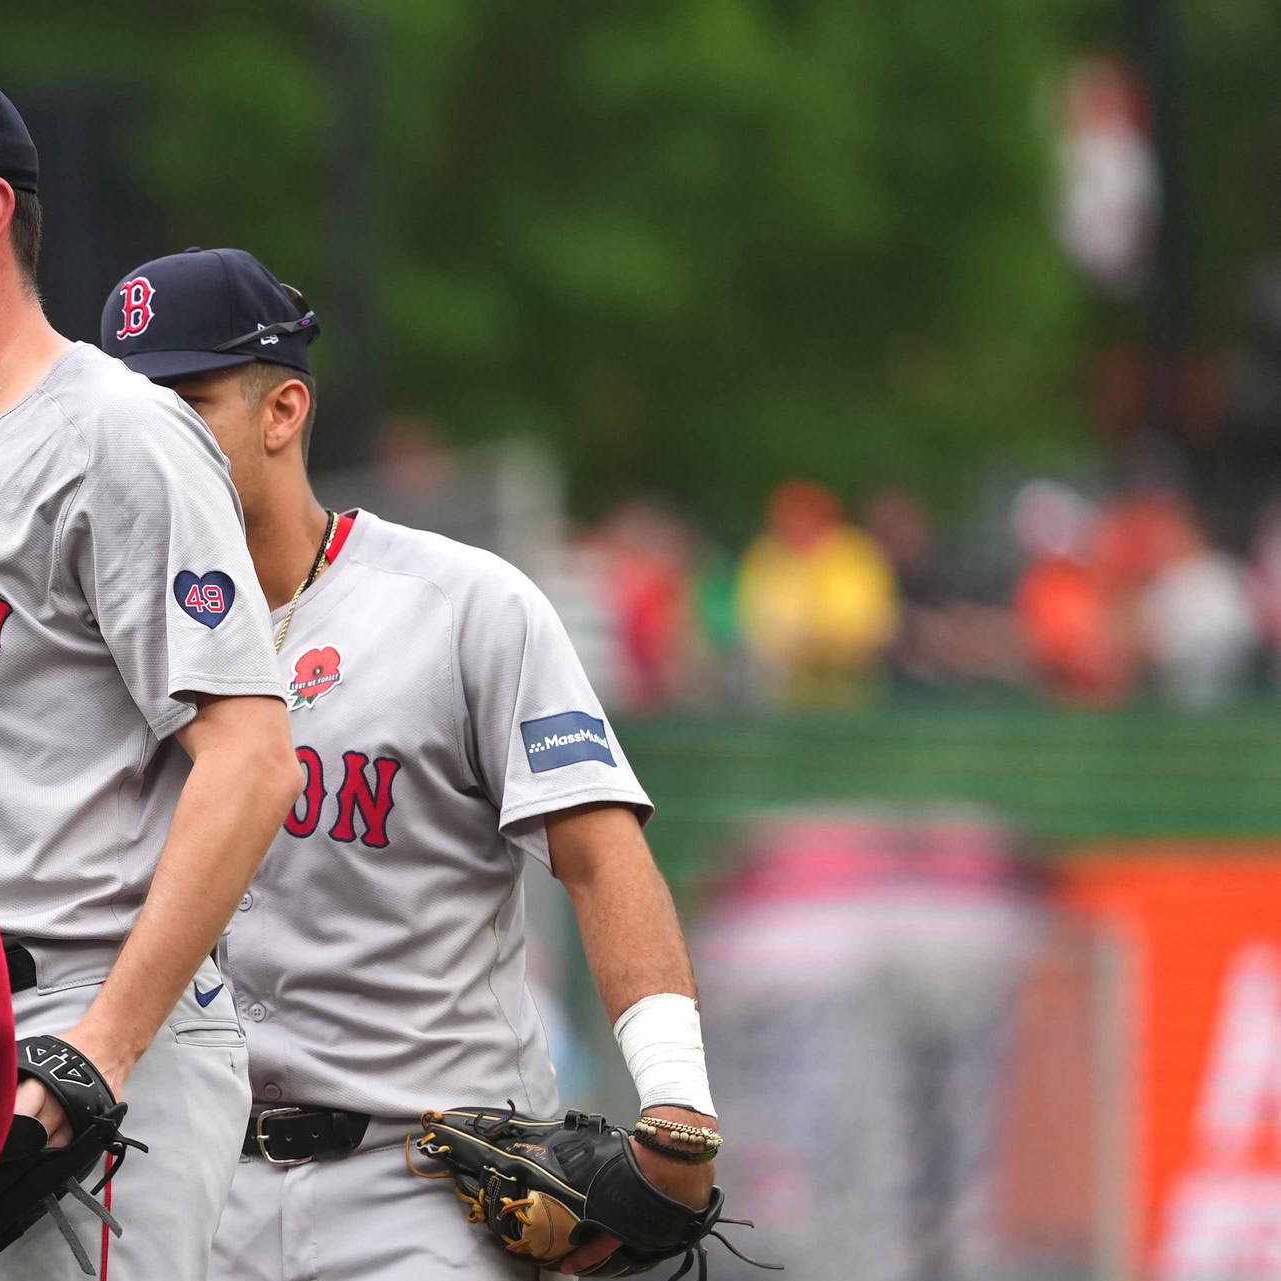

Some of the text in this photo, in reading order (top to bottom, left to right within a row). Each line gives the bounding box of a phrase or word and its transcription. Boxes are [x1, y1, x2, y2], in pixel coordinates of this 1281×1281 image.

[116, 276, 156, 340] B
[184, 584, 225, 613] 49
[291, 682, 306, 690] LEST
[317, 673, 340, 684] FORGET
